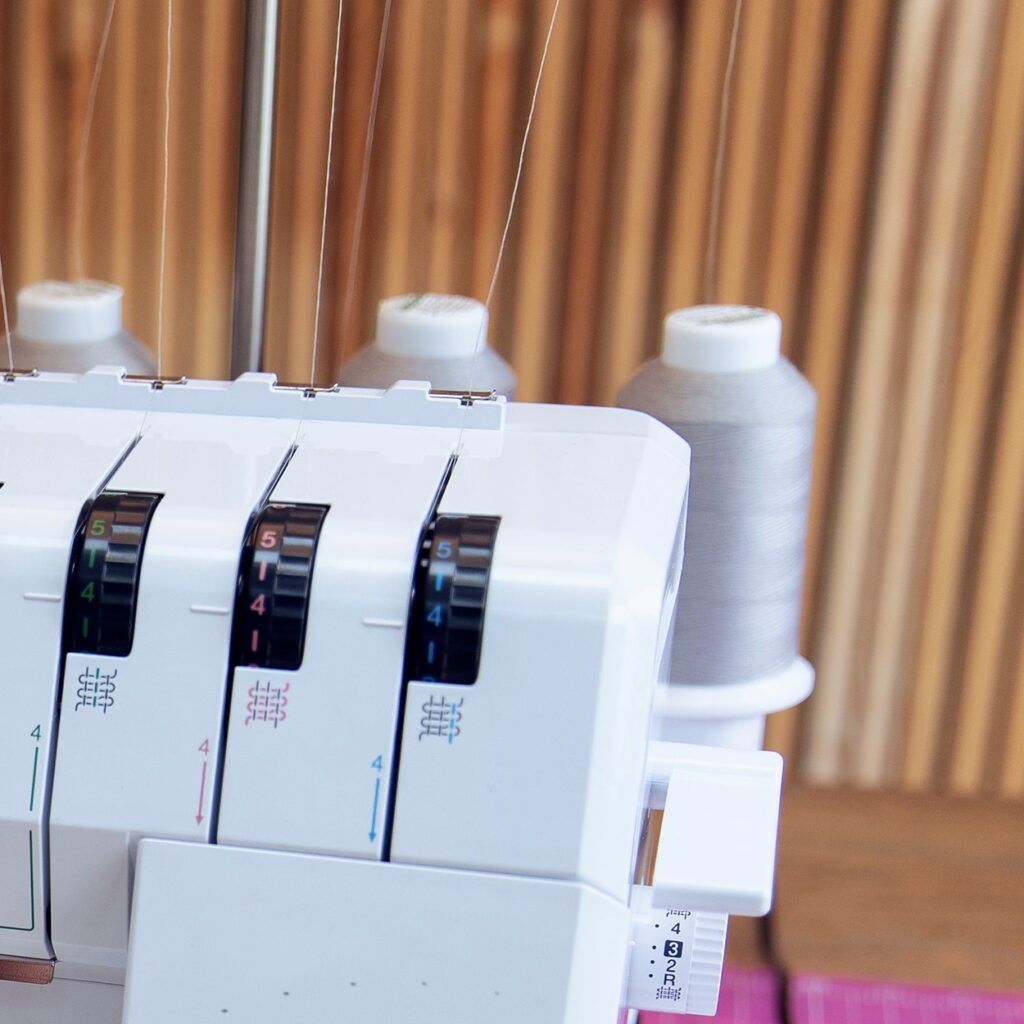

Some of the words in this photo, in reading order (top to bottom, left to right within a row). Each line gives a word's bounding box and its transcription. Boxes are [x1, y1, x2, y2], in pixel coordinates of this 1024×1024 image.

[90, 520, 106, 536] 5
[261, 531, 277, 548] 5
[436, 542, 452, 559] 5
[81, 581, 95, 602] 4
[250, 594, 266, 616] 4
[427, 605, 442, 626] 4
[30, 724, 42, 741] 4
[198, 738, 210, 757] 4
[371, 754, 383, 772] 4
[670, 922, 681, 935] 4
[667, 942, 679, 956] 3
[666, 959, 677, 973] 2
[663, 973, 676, 986] R
